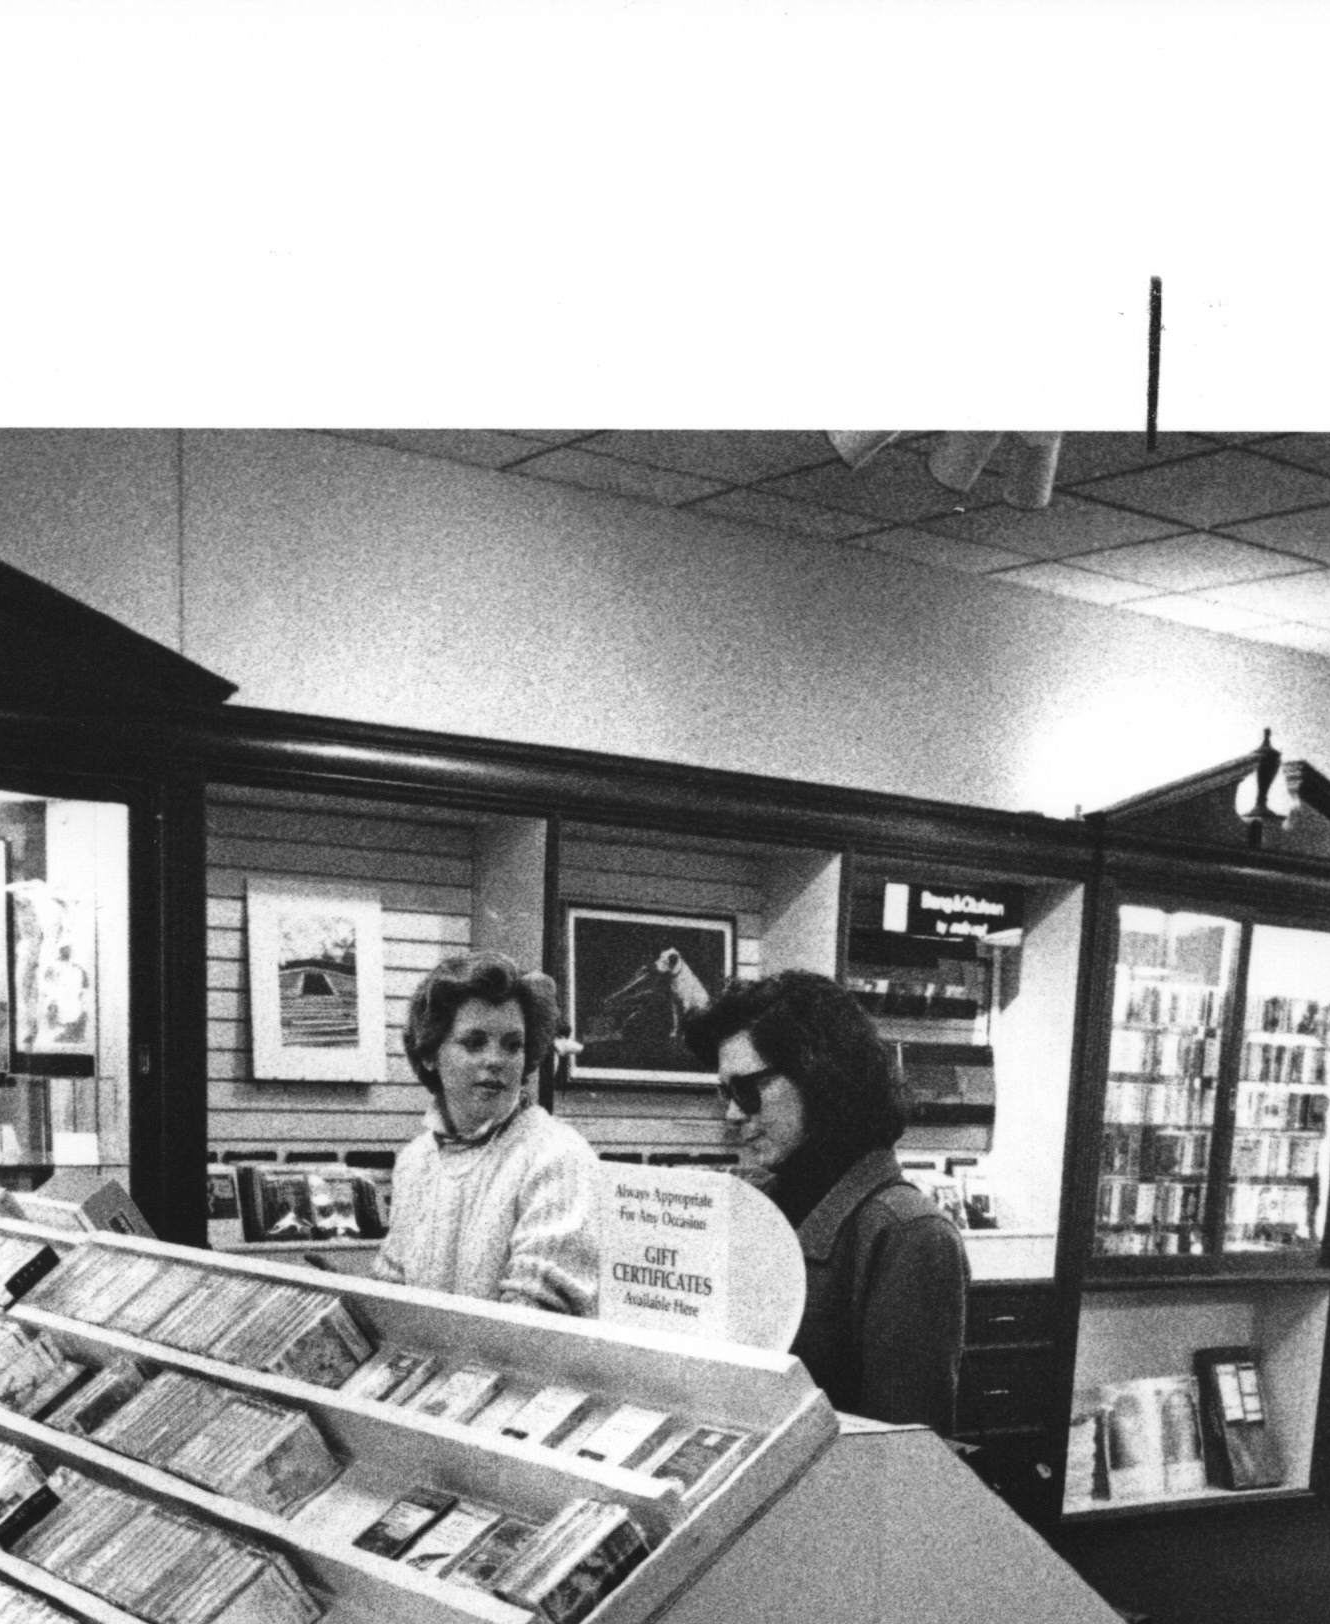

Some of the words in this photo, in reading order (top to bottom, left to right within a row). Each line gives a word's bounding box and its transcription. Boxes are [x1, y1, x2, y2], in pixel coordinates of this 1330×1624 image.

[615, 1184, 650, 1201] Always
[653, 1187, 713, 1209] Appropriate
[619, 1206, 636, 1221] For
[639, 1208, 658, 1227] Any
[662, 1211, 706, 1230] Occasion
[644, 1246, 678, 1266] GIFT
[612, 1263, 712, 1295] CERTIFICATES
[623, 1292, 670, 1312] Available
[673, 1299, 699, 1317] Here
